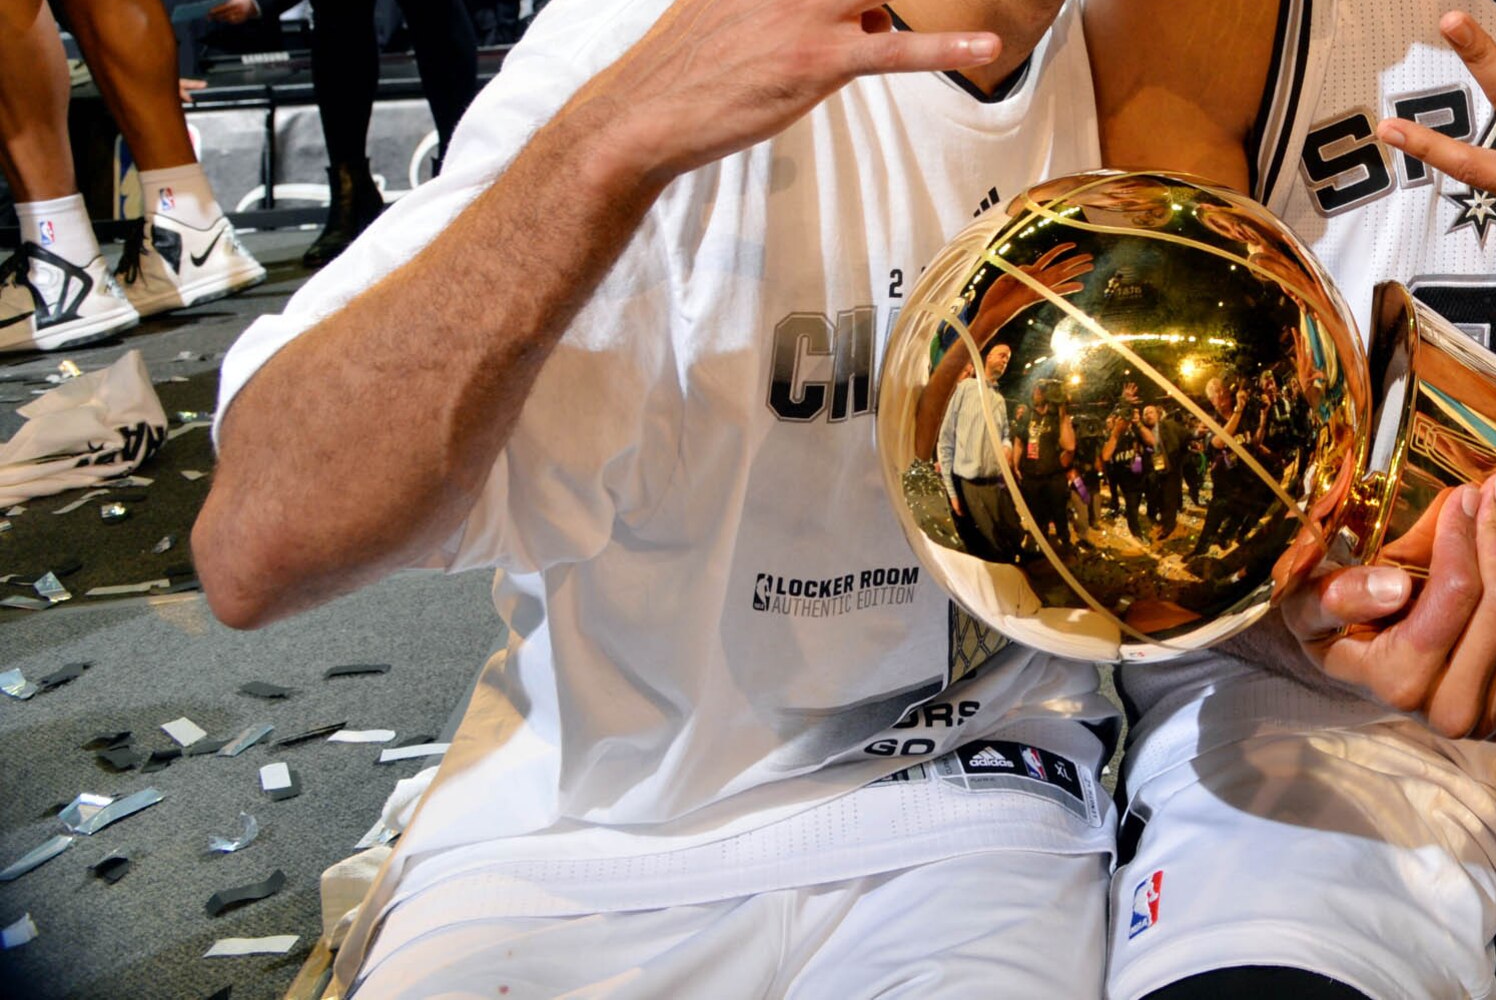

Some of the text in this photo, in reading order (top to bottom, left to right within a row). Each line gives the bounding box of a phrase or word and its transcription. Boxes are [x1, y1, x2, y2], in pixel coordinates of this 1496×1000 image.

[766, 304, 902, 424] CH
[776, 567, 919, 599] LOCKER ROOM
[771, 586, 916, 618] AUTHENTIC EDITION
[864, 738, 935, 756] GO
[969, 758, 1015, 768] adidas
